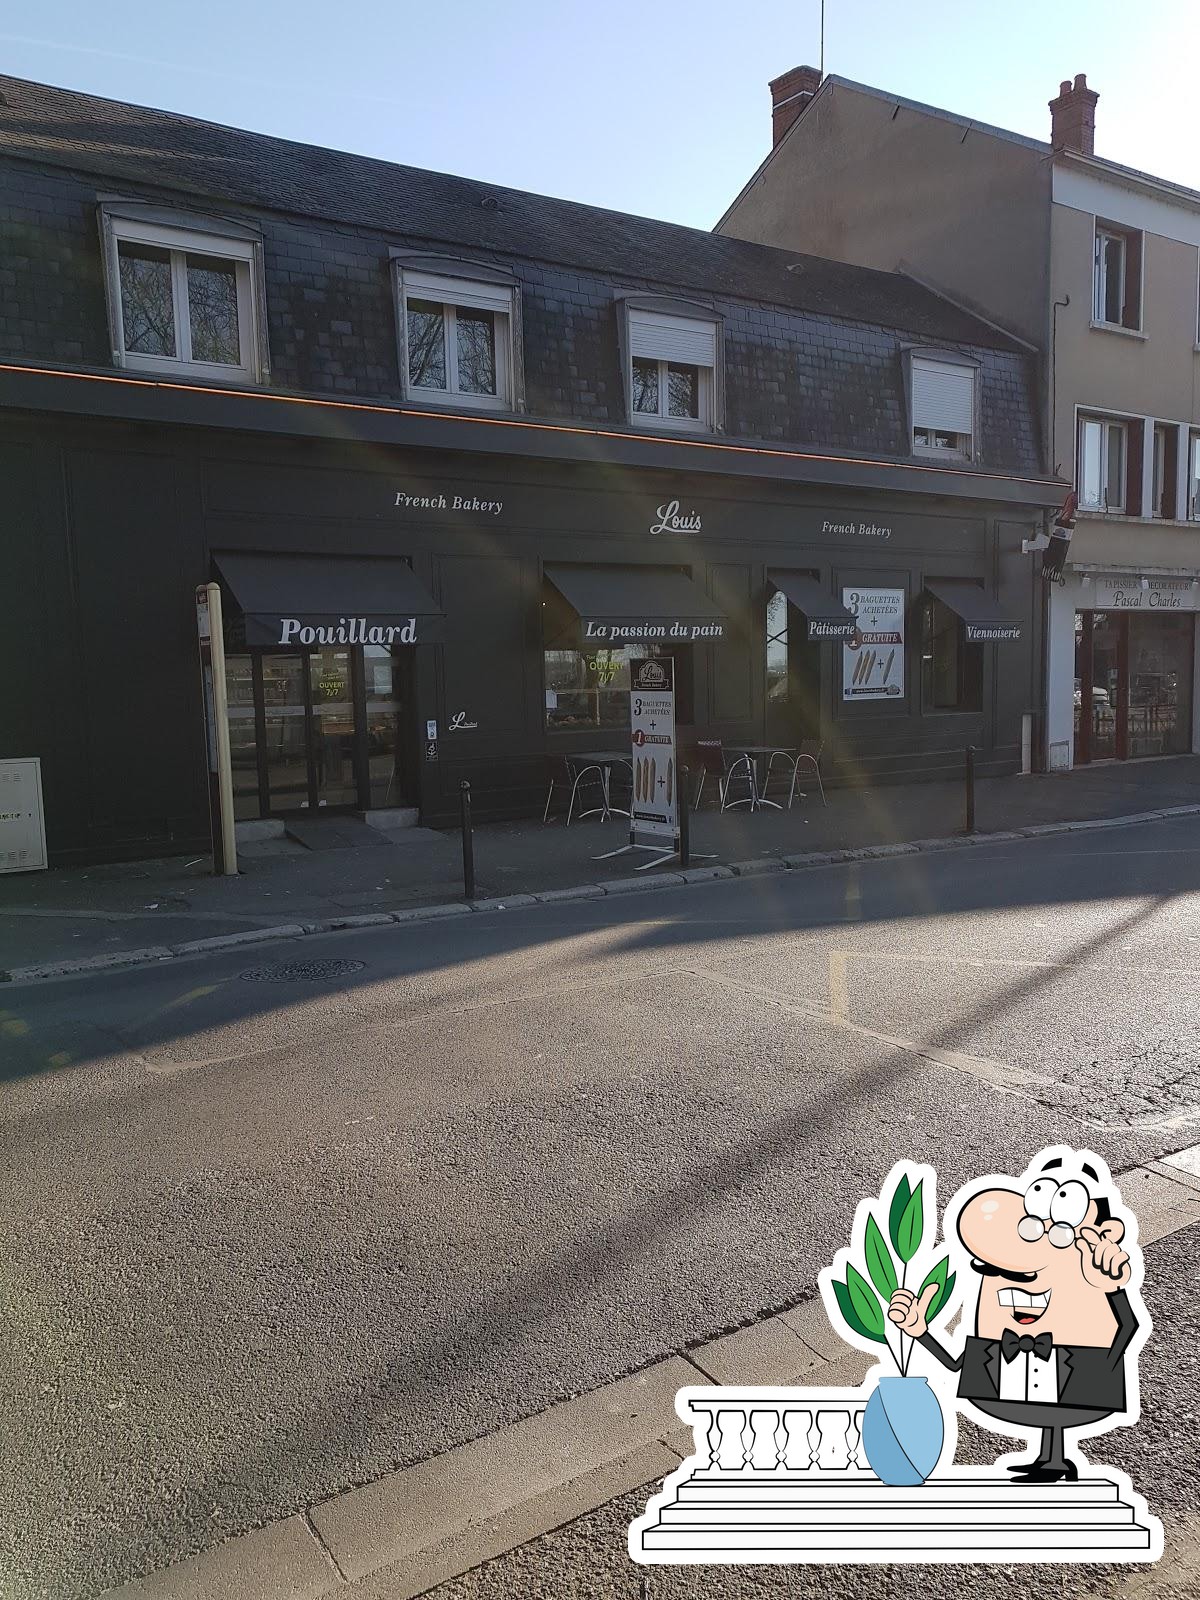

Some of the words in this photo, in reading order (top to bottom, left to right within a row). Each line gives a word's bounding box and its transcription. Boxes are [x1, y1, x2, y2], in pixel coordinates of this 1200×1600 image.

[394, 492, 447, 509] French
[452, 496, 503, 515] Bakery
[650, 500, 701, 535] Louis
[822, 521, 856, 534] French
[859, 523, 892, 539] Bakery
[1104, 580, 1138, 589] TAPISSIER
[847, 592, 860, 615] 3
[860, 595, 900, 604] BAGUETTES
[1113, 590, 1143, 607] Pascal
[1148, 591, 1181, 607] Charles
[862, 605, 898, 614] ACHETÉES
[278, 618, 417, 645] Pouillard
[586, 621, 607, 637] La
[608, 622, 666, 640] passion
[669, 621, 688, 637] du
[691, 622, 723, 639] pain
[809, 621, 855, 635] Pâtisserie
[967, 626, 1021, 639] Viennoiserie
[862, 633, 898, 643] GRATUITE
[589, 661, 624, 671] OUVERT
[319, 681, 345, 689] OUVERT
[634, 698, 642, 716] 3
[636, 731, 642, 745] 1
[644, 735, 669, 744] GRATUITE
